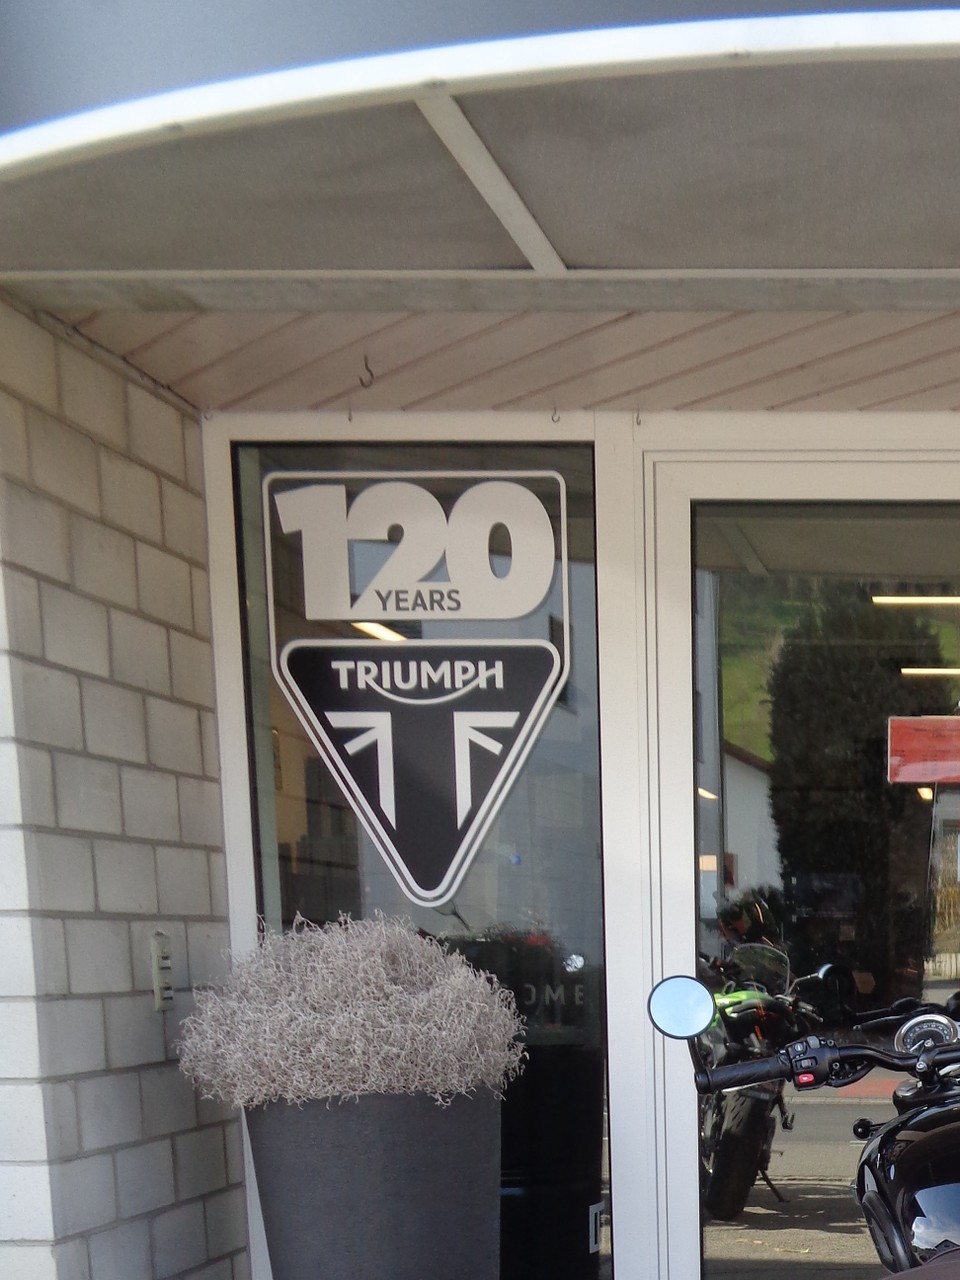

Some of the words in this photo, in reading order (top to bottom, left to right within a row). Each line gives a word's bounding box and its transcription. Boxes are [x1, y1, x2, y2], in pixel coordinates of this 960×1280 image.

[274, 480, 556, 620] 120
[374, 588, 462, 612] YEARS
[332, 660, 505, 704] TRIUMPH
